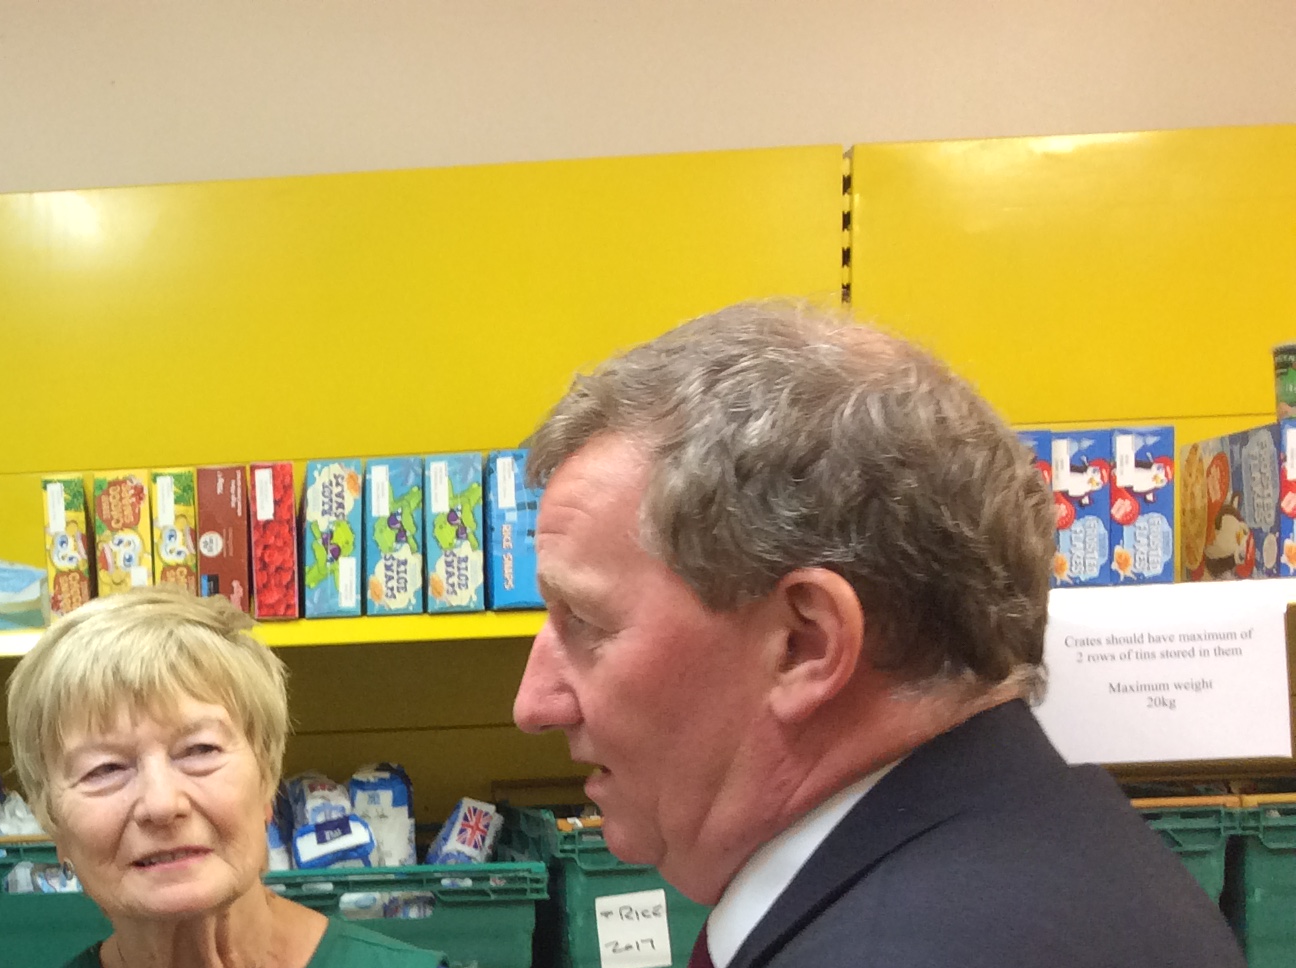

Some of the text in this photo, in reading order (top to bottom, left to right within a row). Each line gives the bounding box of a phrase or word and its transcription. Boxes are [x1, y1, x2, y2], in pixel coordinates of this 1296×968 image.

[1064, 628, 1255, 648] Crates should have maximum of
[1076, 645, 1243, 663] 2 rows of tins stored in them
[1108, 678, 1214, 694] Maximum weight
[1146, 695, 1176, 710] 20kg
